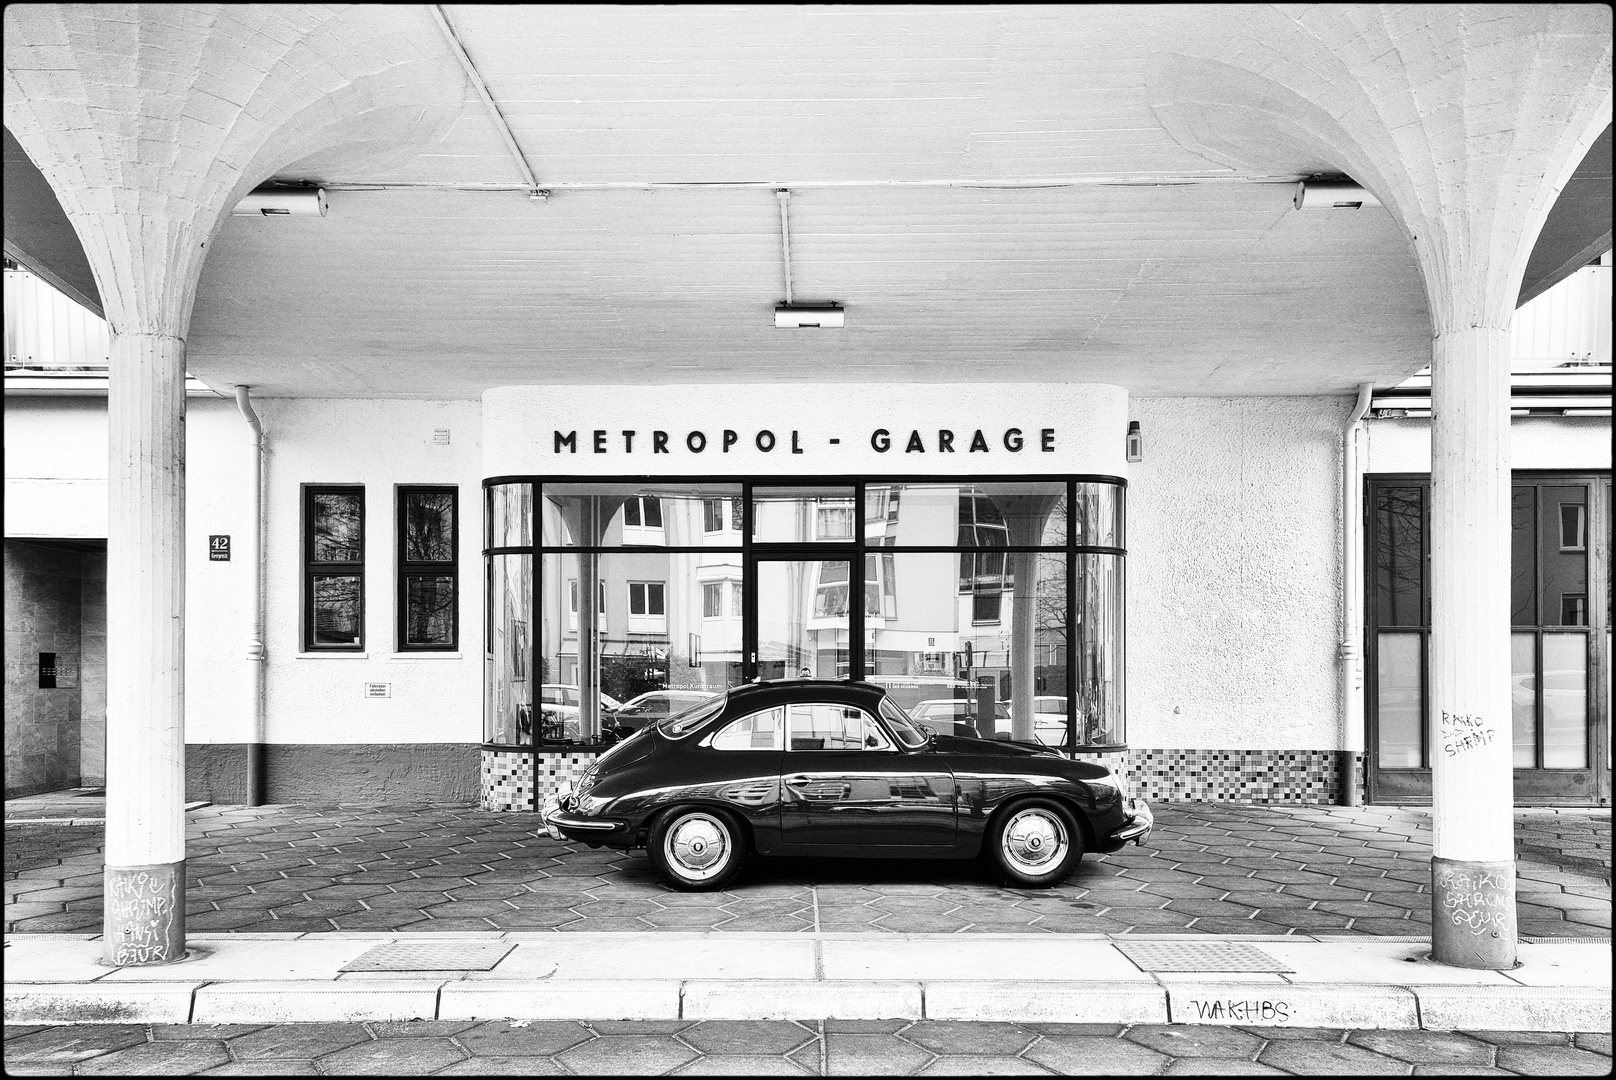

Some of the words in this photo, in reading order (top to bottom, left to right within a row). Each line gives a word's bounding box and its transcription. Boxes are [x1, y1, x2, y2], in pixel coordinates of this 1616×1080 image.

[553, 430, 804, 454] METROPOL
[870, 428, 1055, 453] GARAGE
[211, 537, 229, 549] 42
